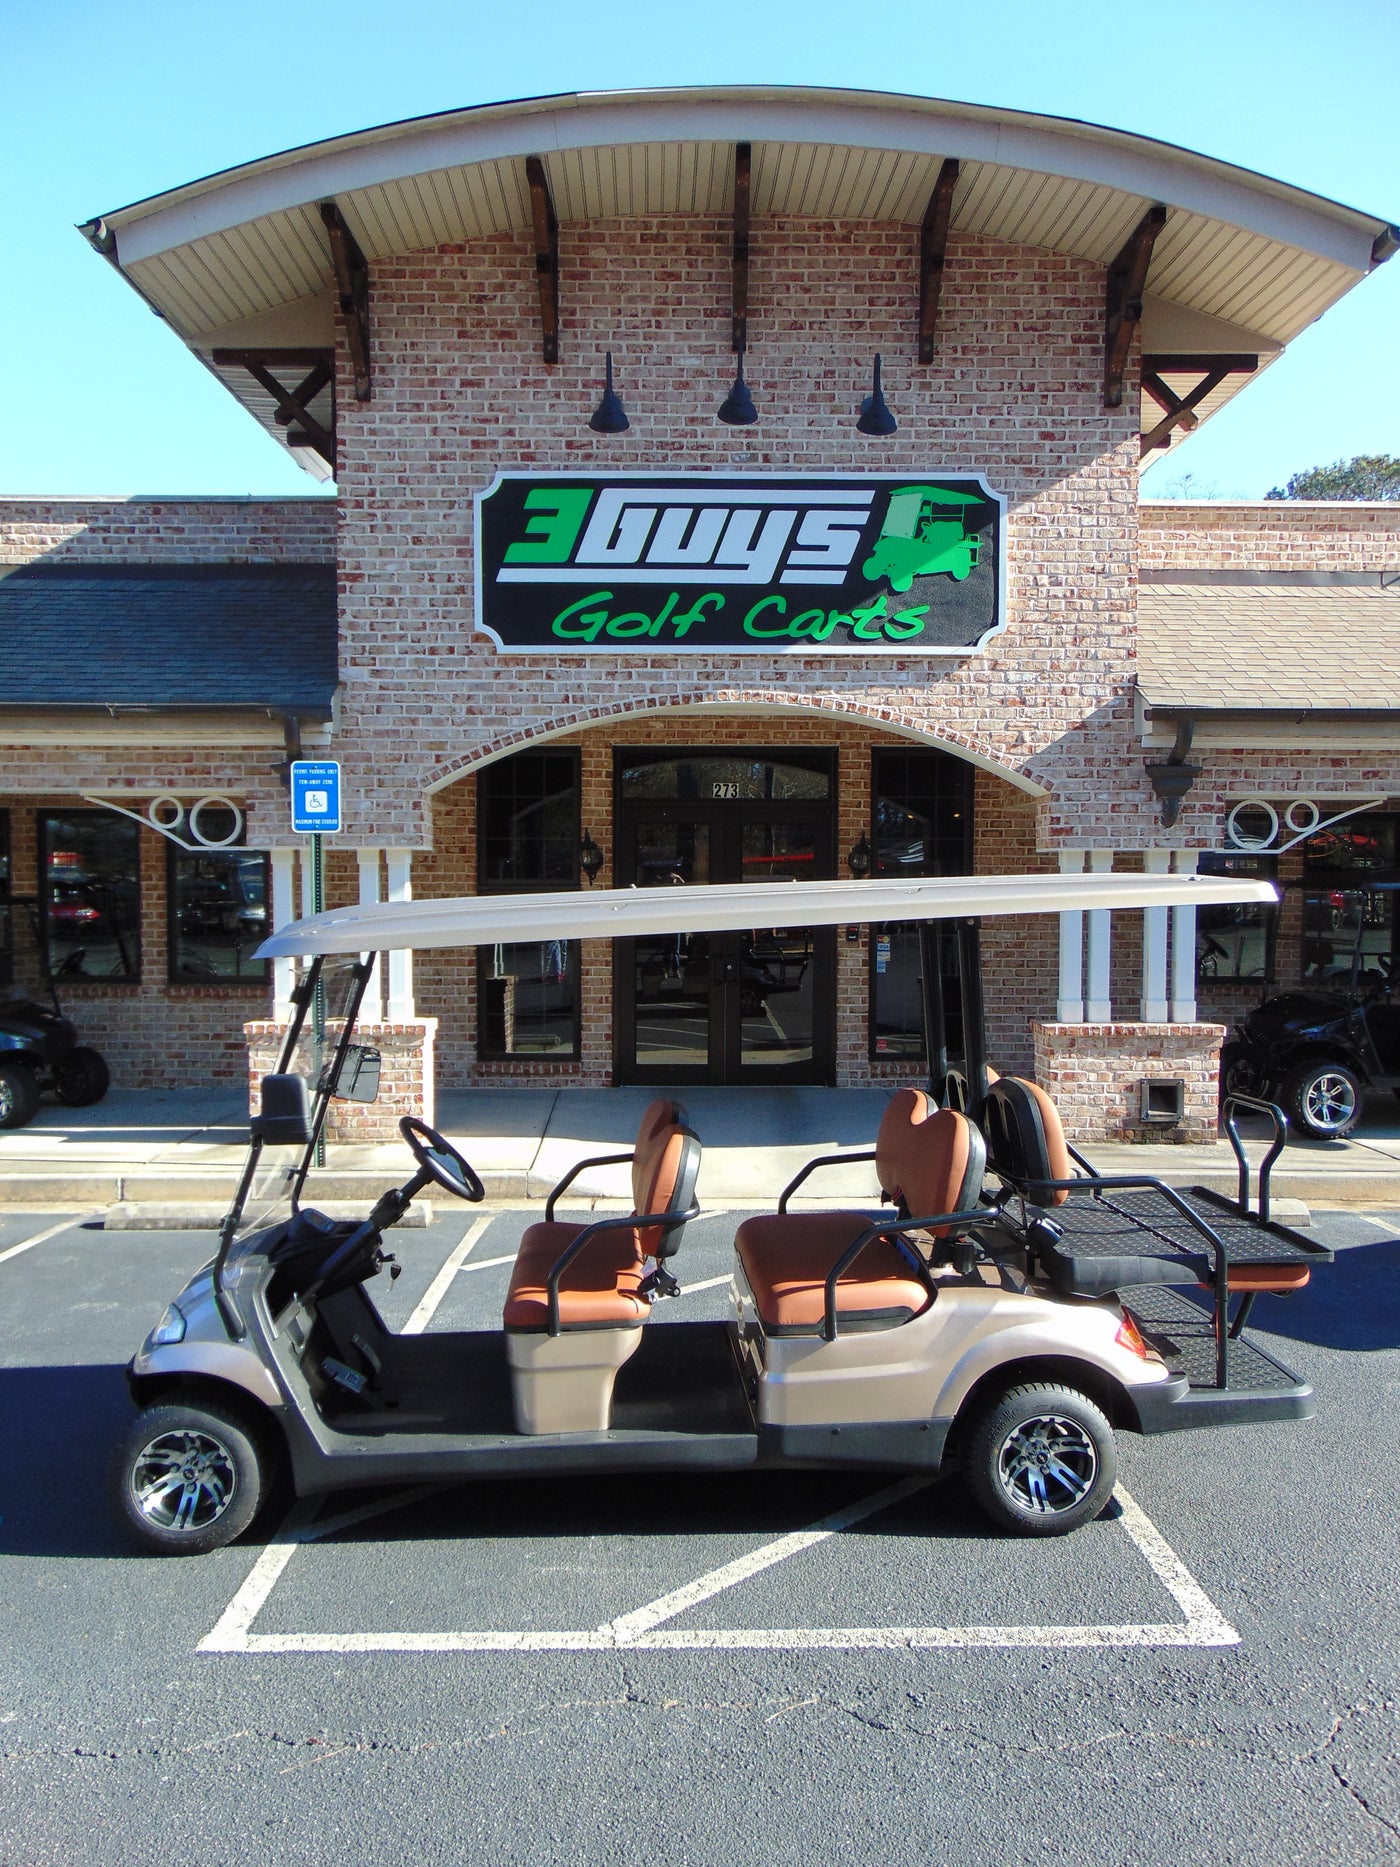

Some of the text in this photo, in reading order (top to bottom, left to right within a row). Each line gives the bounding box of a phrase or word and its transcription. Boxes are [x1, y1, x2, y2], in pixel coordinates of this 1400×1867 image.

[551, 591, 931, 642] Golf Carts
[714, 783, 738, 798] 273
